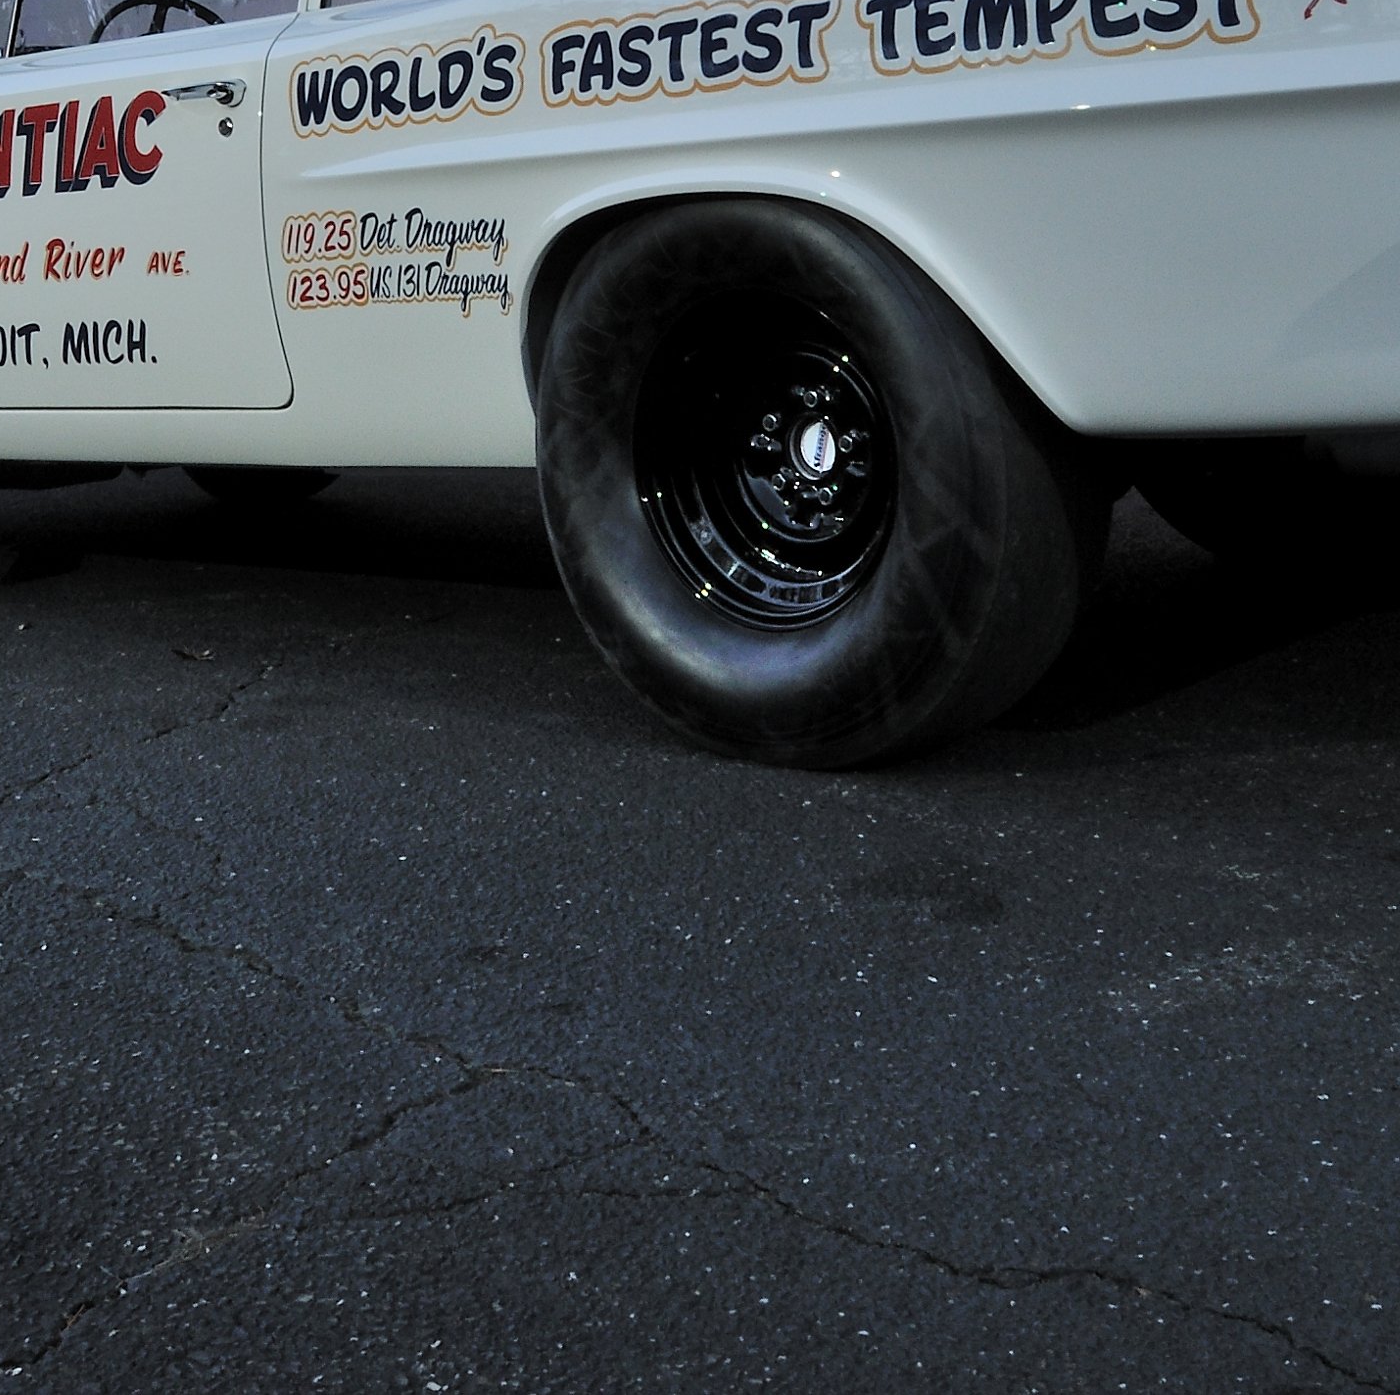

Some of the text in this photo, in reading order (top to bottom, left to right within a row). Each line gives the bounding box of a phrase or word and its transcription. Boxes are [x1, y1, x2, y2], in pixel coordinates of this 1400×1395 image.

[294, 34, 517, 128] WORLD'S
[550, 1, 832, 97] FASTEST
[44, 237, 127, 282] River
[146, 248, 191, 278] AVE.
[286, 217, 353, 255] 119.25
[404, 207, 506, 267] Dragway
[290, 267, 367, 304] 123.95
[397, 263, 421, 299] 131
[424, 261, 511, 313] Dragway
[61, 318, 159, 367] MICH.
